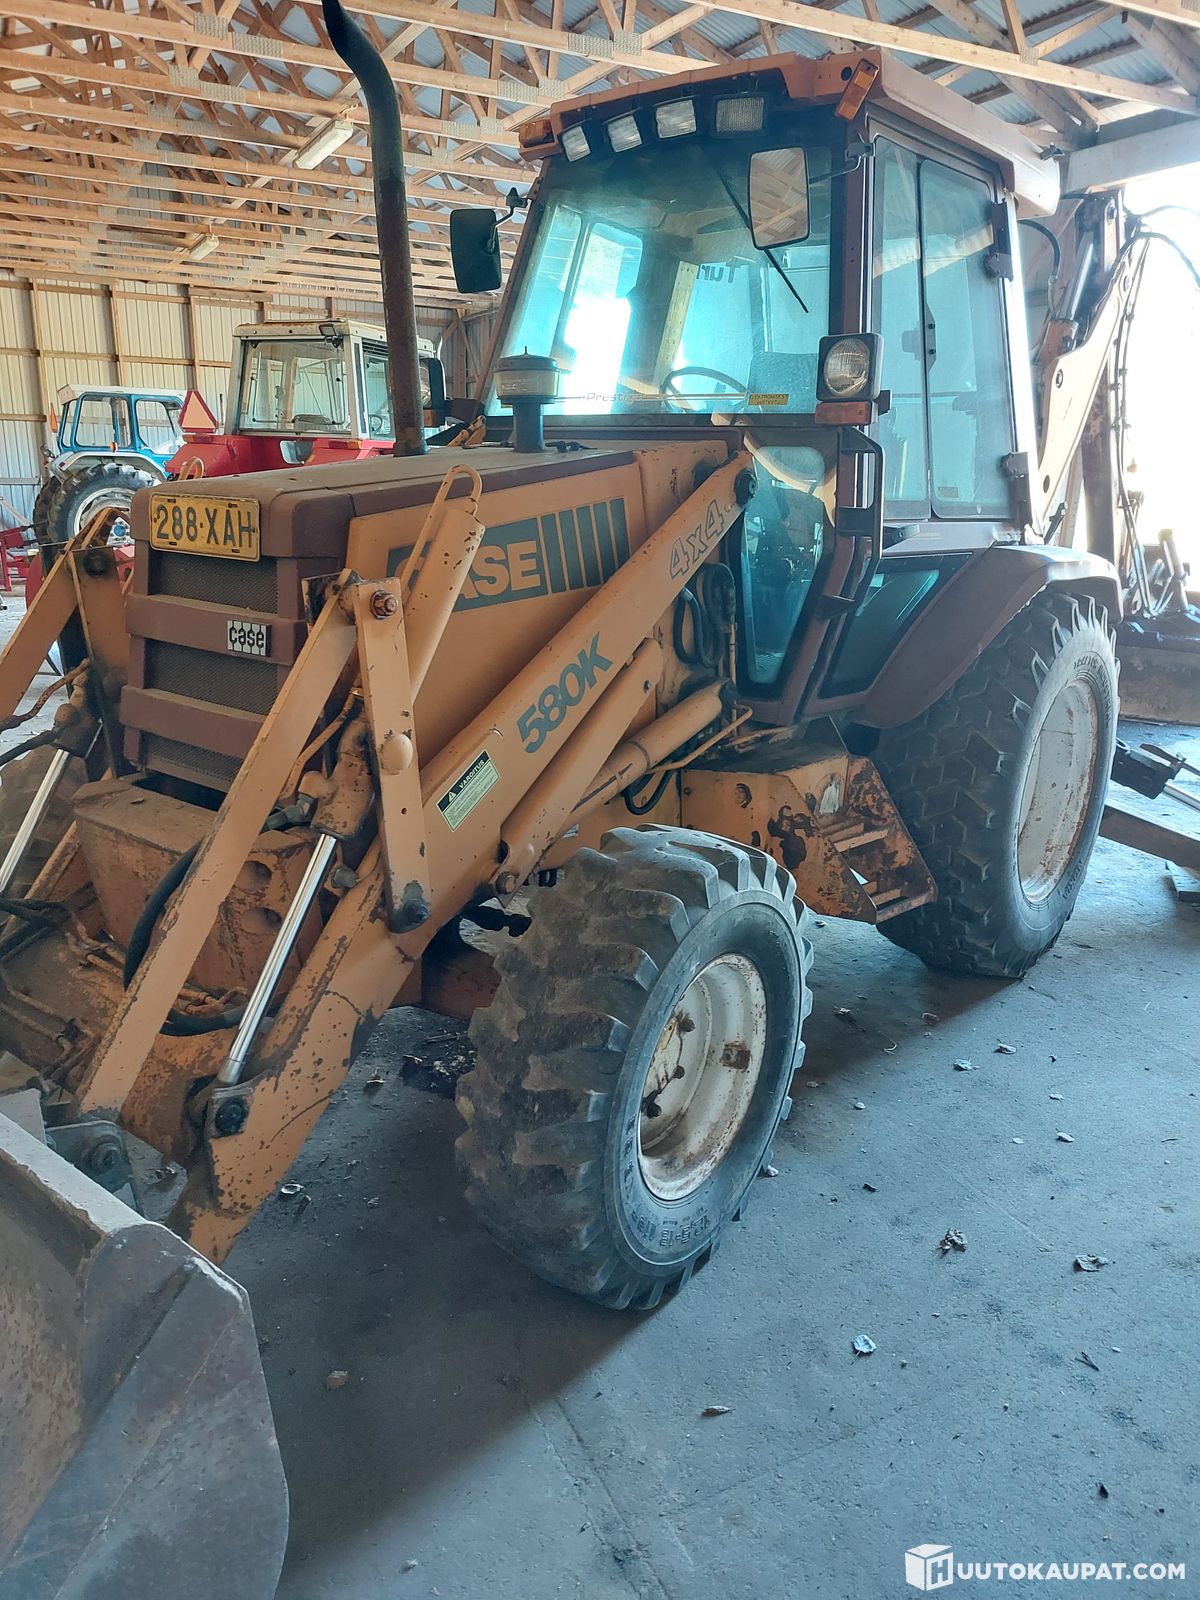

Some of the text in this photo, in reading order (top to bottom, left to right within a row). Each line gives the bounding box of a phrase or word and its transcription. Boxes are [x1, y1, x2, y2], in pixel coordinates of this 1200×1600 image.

[157, 504, 252, 549] 288-XAH
[517, 631, 614, 754] 580K
[458, 759, 485, 789] VAROITUS
